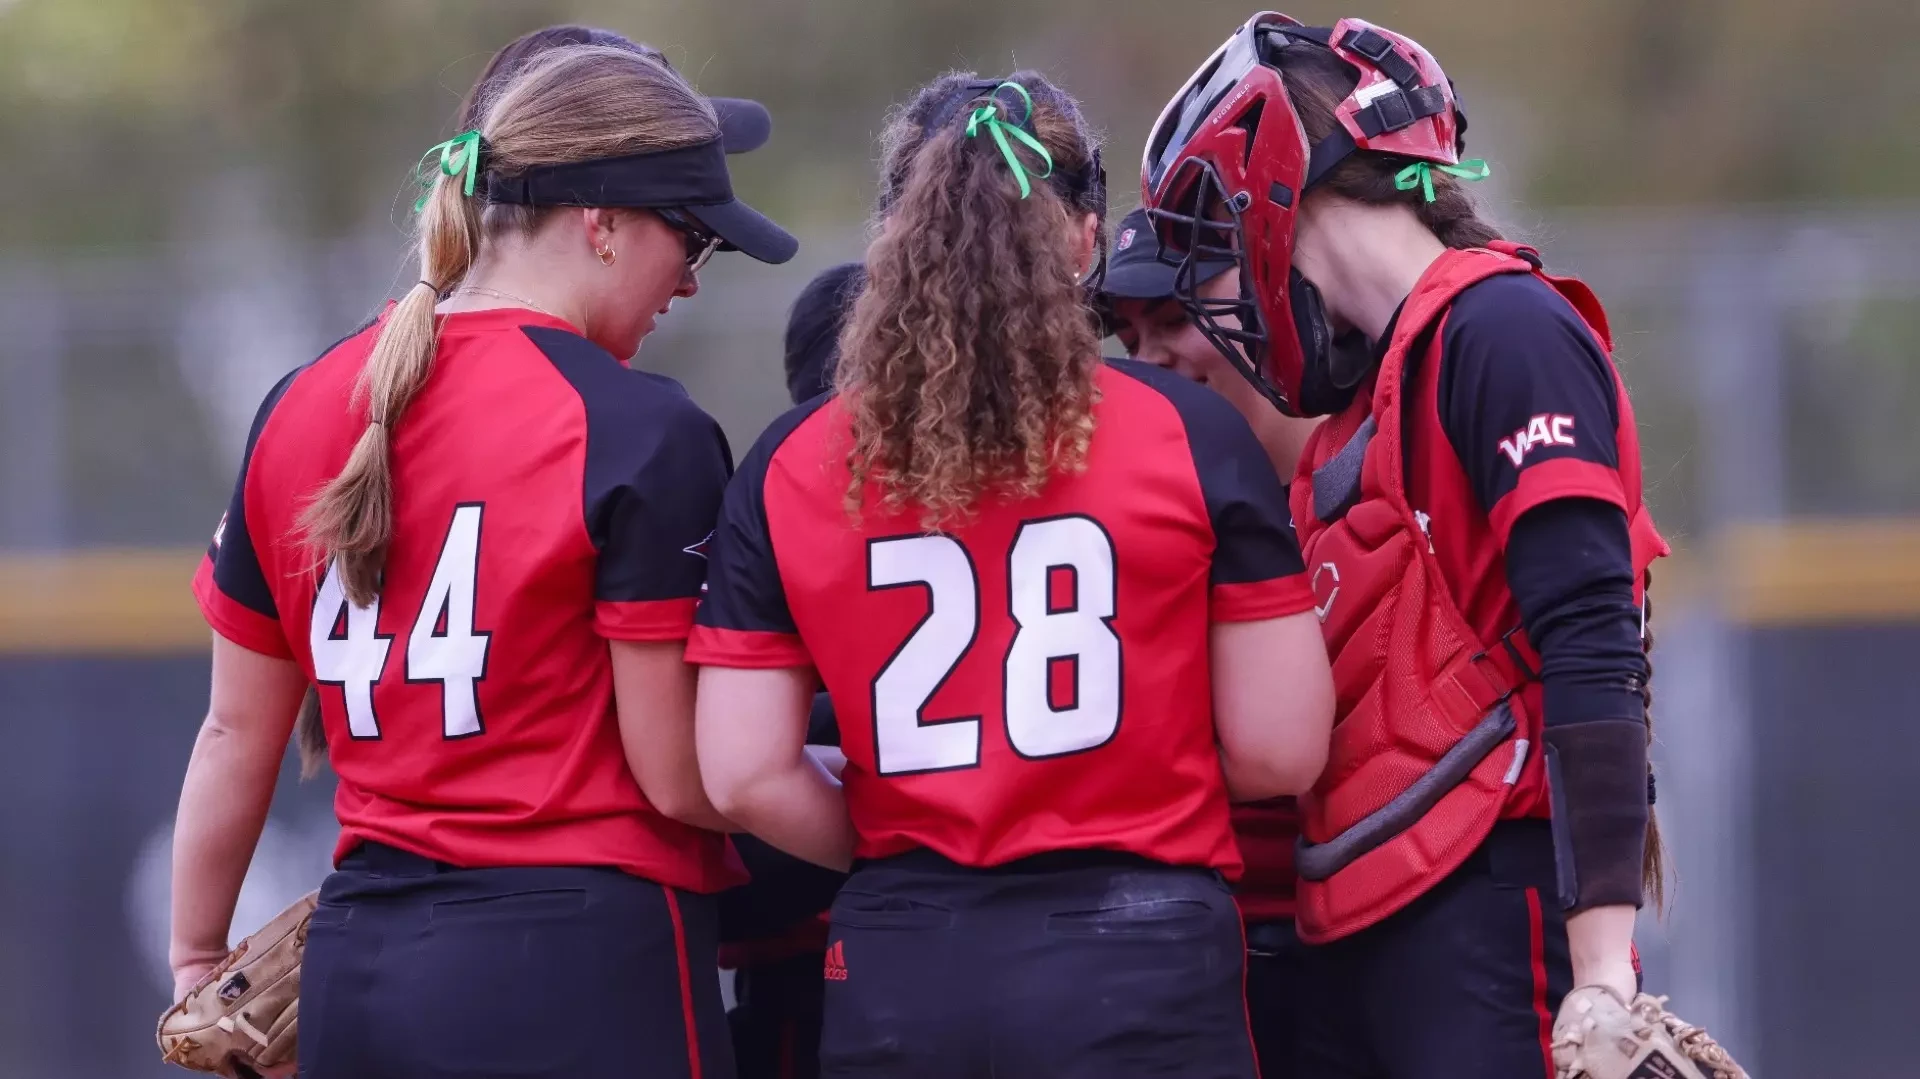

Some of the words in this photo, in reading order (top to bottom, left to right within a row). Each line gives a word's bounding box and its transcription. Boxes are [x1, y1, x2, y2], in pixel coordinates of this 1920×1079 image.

[1498, 412, 1576, 468] WAC
[309, 501, 493, 742] 44
[866, 512, 1124, 777] 28
